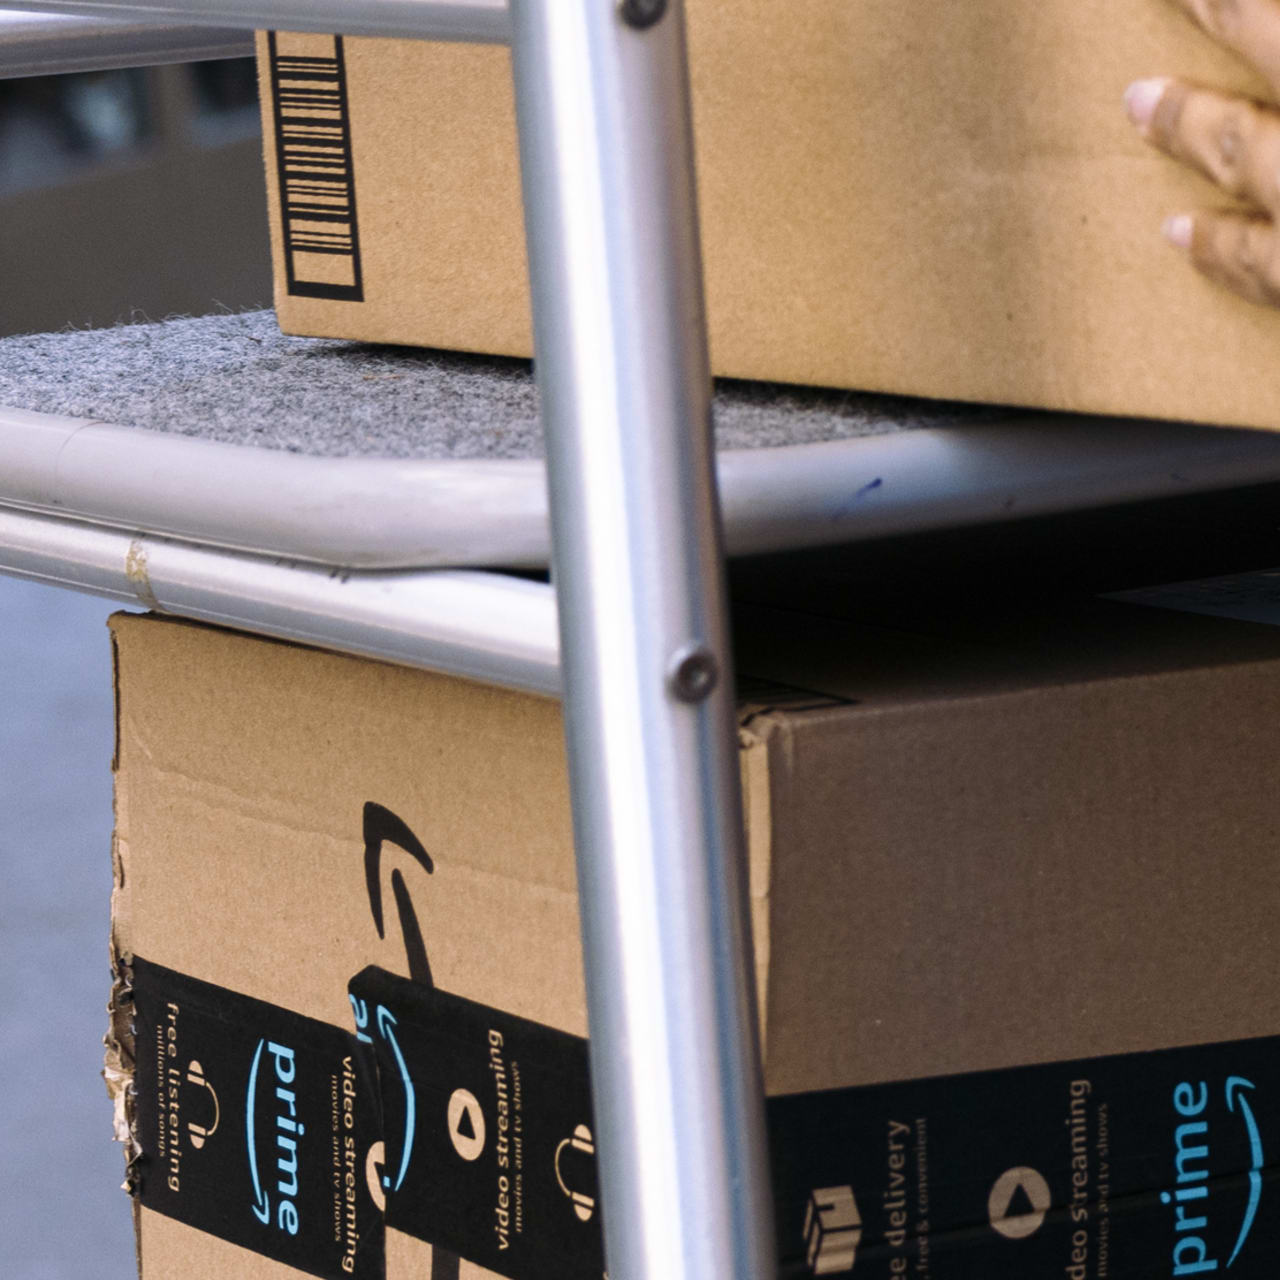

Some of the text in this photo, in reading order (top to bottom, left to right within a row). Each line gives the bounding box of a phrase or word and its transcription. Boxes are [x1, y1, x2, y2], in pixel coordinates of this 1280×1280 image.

[166, 1002, 182, 1192] free listening
[268, 1040, 305, 1236] prime
[341, 1055, 360, 1274] video streaming
[487, 1028, 510, 1251] video streaming
[882, 1120, 911, 1247] delivery
[1160, 1080, 1219, 1277] prime
